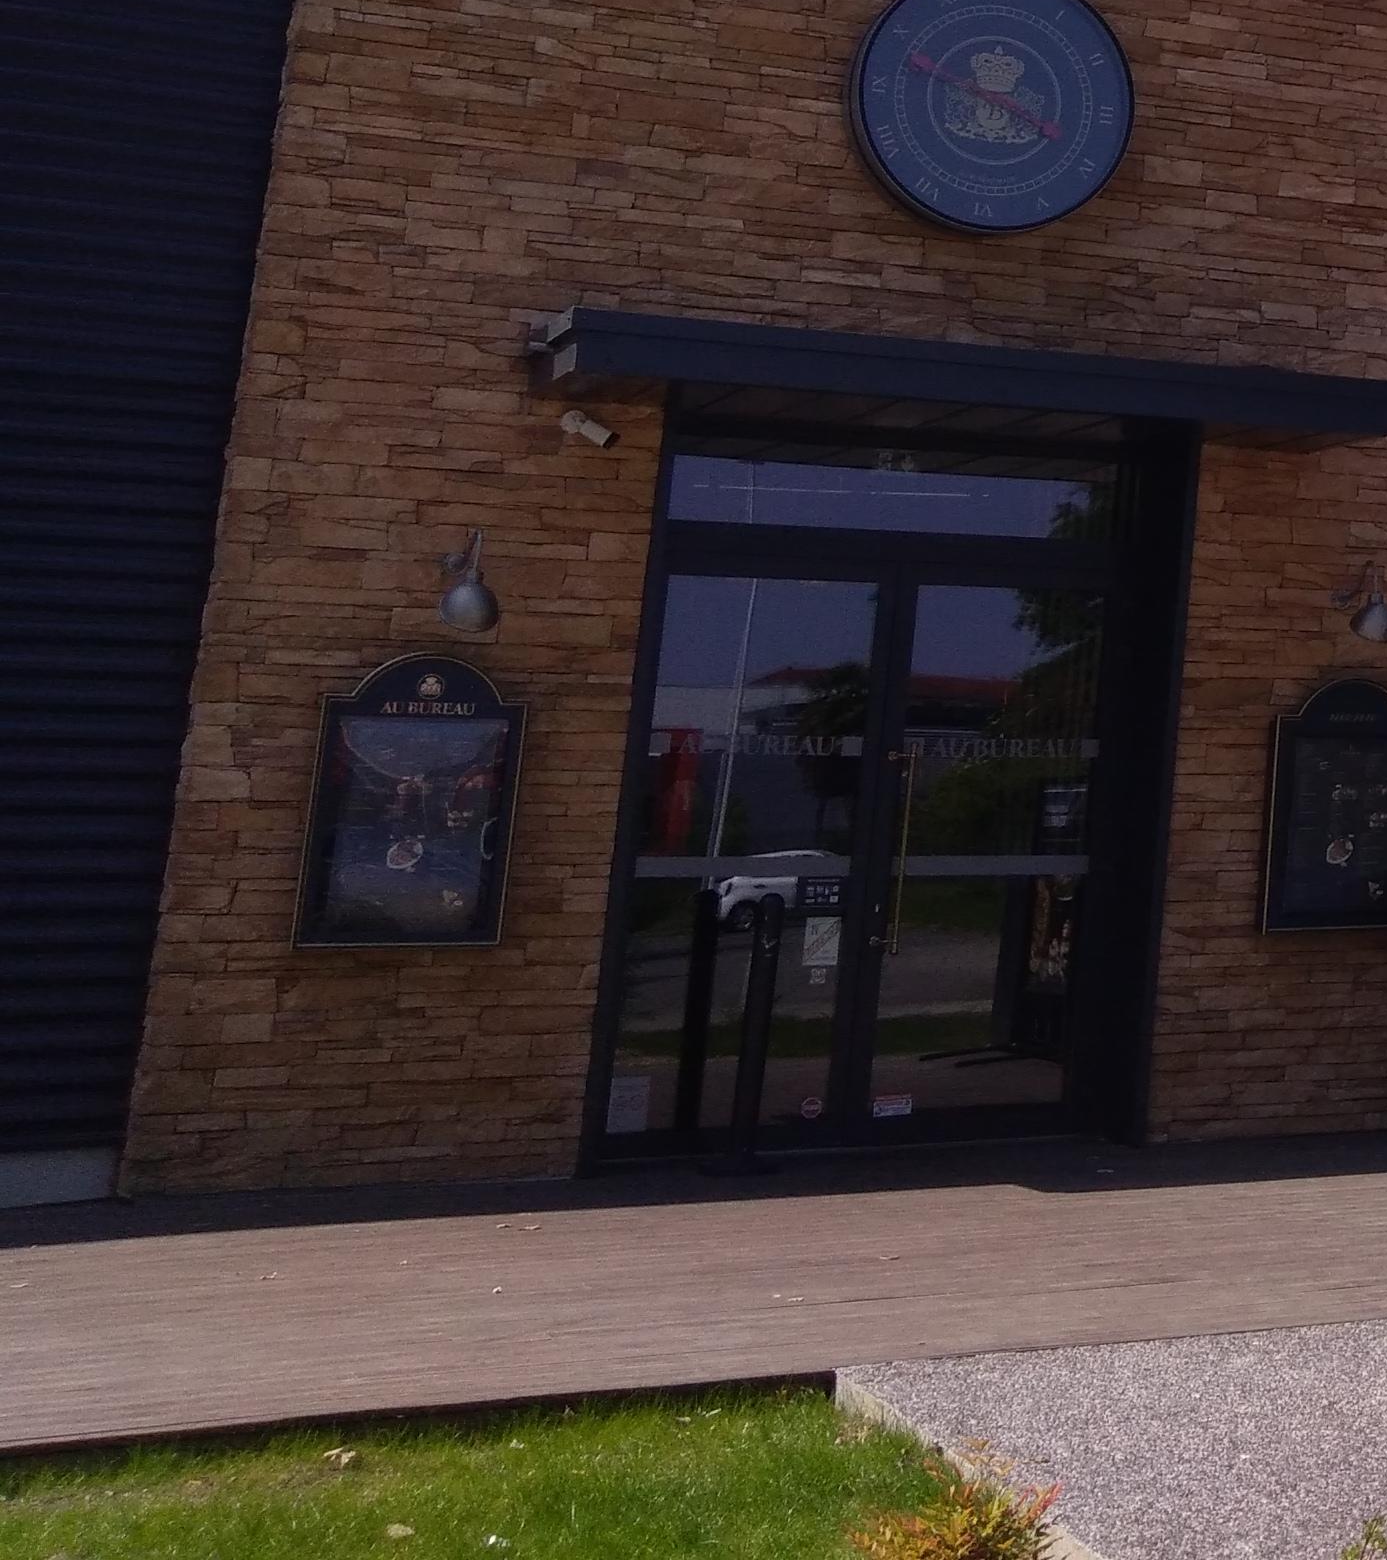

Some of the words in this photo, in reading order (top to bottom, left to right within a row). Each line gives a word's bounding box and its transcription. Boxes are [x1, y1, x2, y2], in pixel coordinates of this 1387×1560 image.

[380, 702, 404, 714] AU
[407, 702, 476, 716] BUREAU
[966, 738, 1076, 759] BUREAU
